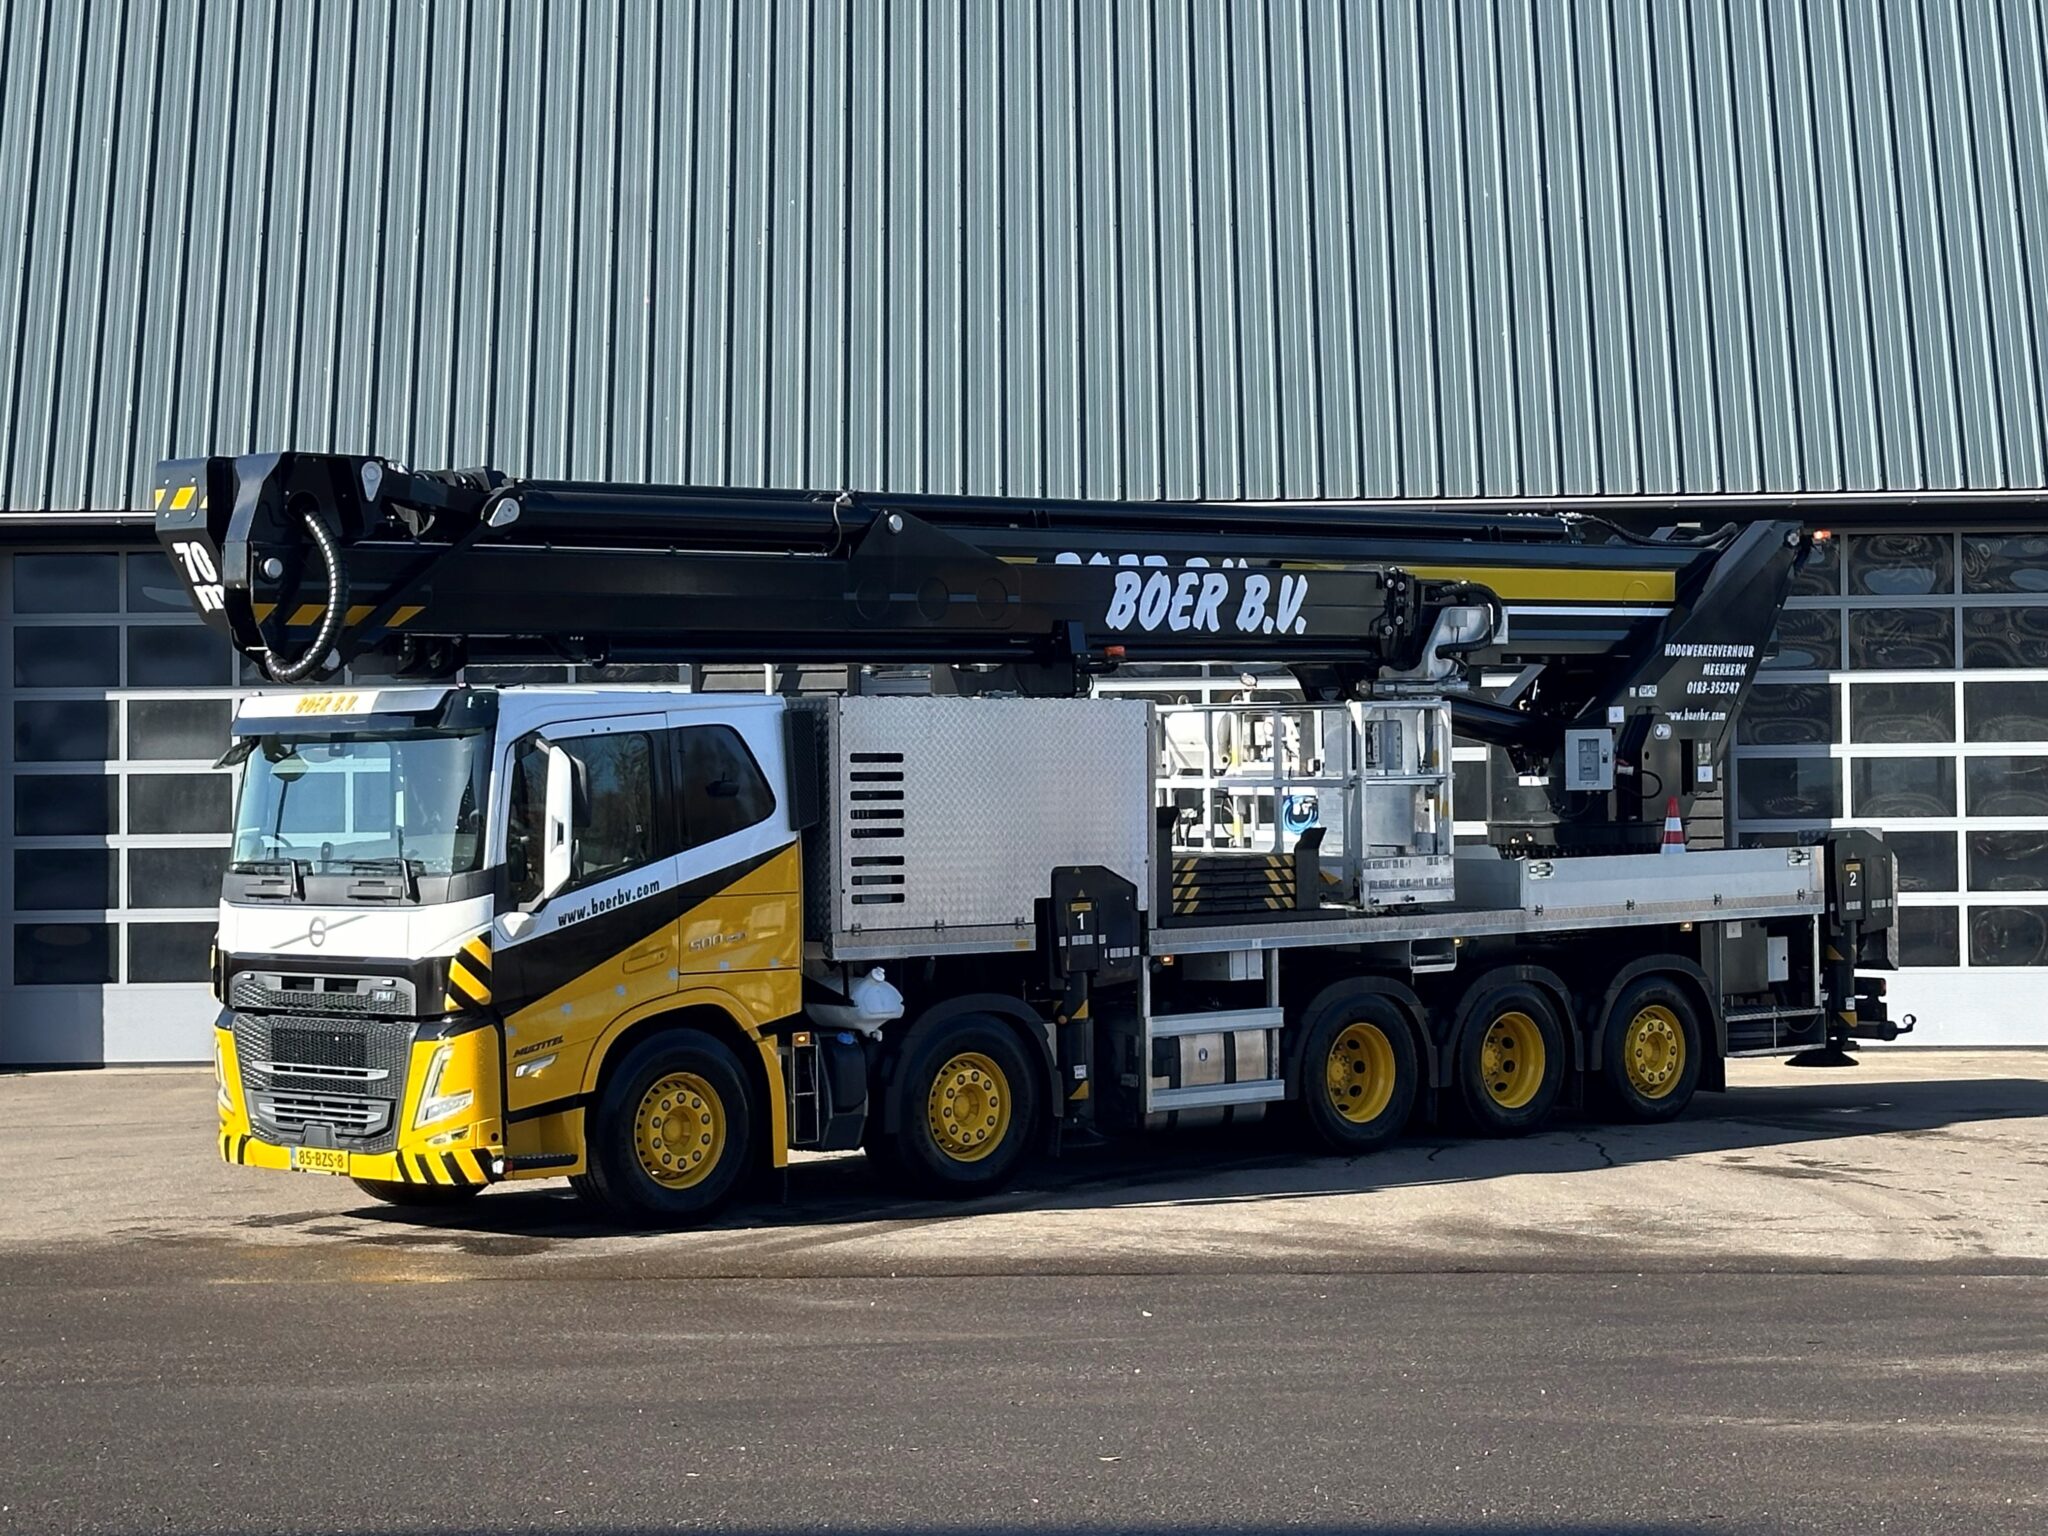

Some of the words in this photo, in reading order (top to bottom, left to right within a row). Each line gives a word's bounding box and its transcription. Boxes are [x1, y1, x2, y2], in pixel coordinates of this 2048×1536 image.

[172, 541, 218, 583] 70
[1105, 570, 1229, 632] BOER
[1235, 574, 1309, 635] B.V.
[1664, 643, 1755, 658] HOOGWERKERVERHUUR
[1702, 663, 1747, 676] MEERKERK
[1686, 681, 1740, 695] 0183-352747
[296, 696, 332, 713] BOER
[1849, 871, 1857, 887] 2
[557, 880, 660, 927] www.boerbv.com
[1076, 912, 1084, 930] 1
[298, 1150, 344, 1169] 85-BZS-8
